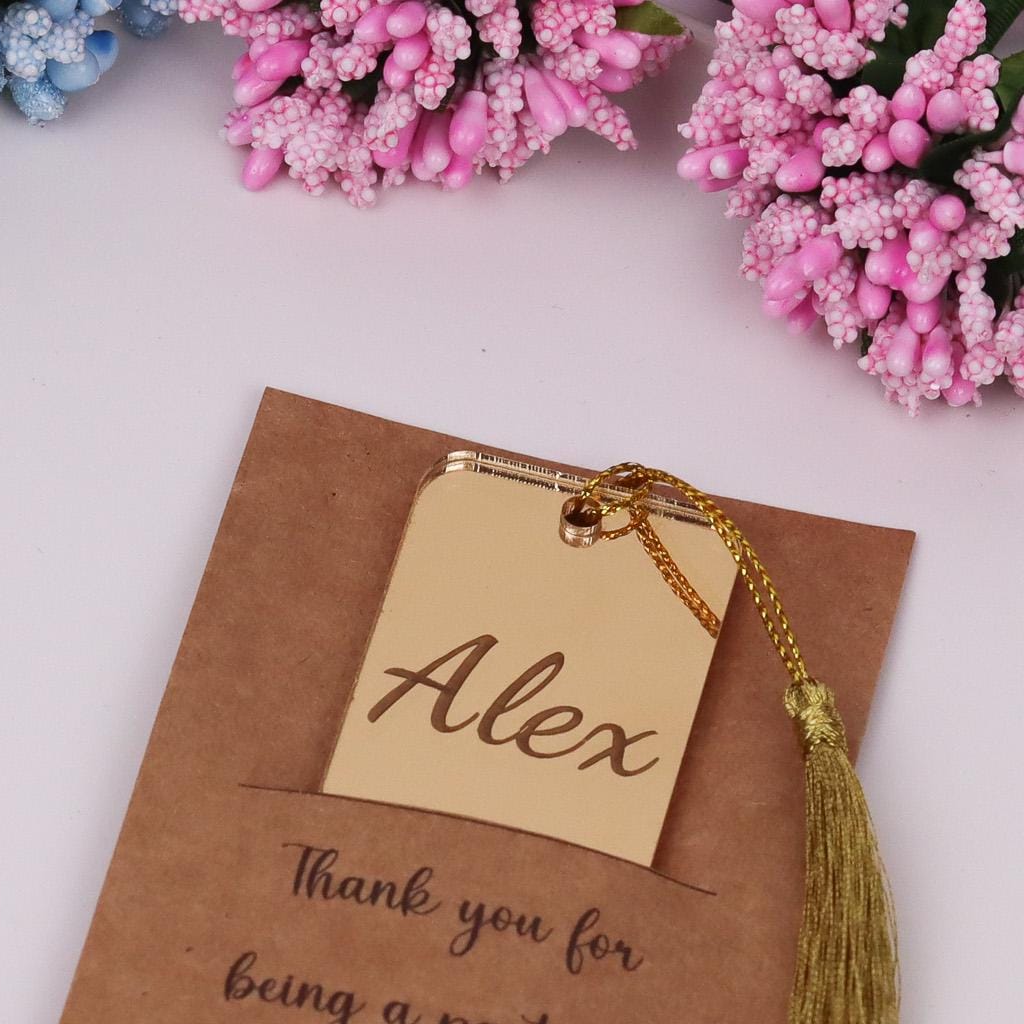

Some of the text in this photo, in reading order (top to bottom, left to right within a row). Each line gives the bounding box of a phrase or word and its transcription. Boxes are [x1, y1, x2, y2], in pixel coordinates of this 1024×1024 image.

[367, 634, 660, 777] Alex
[282, 842, 643, 974] Thank you for
